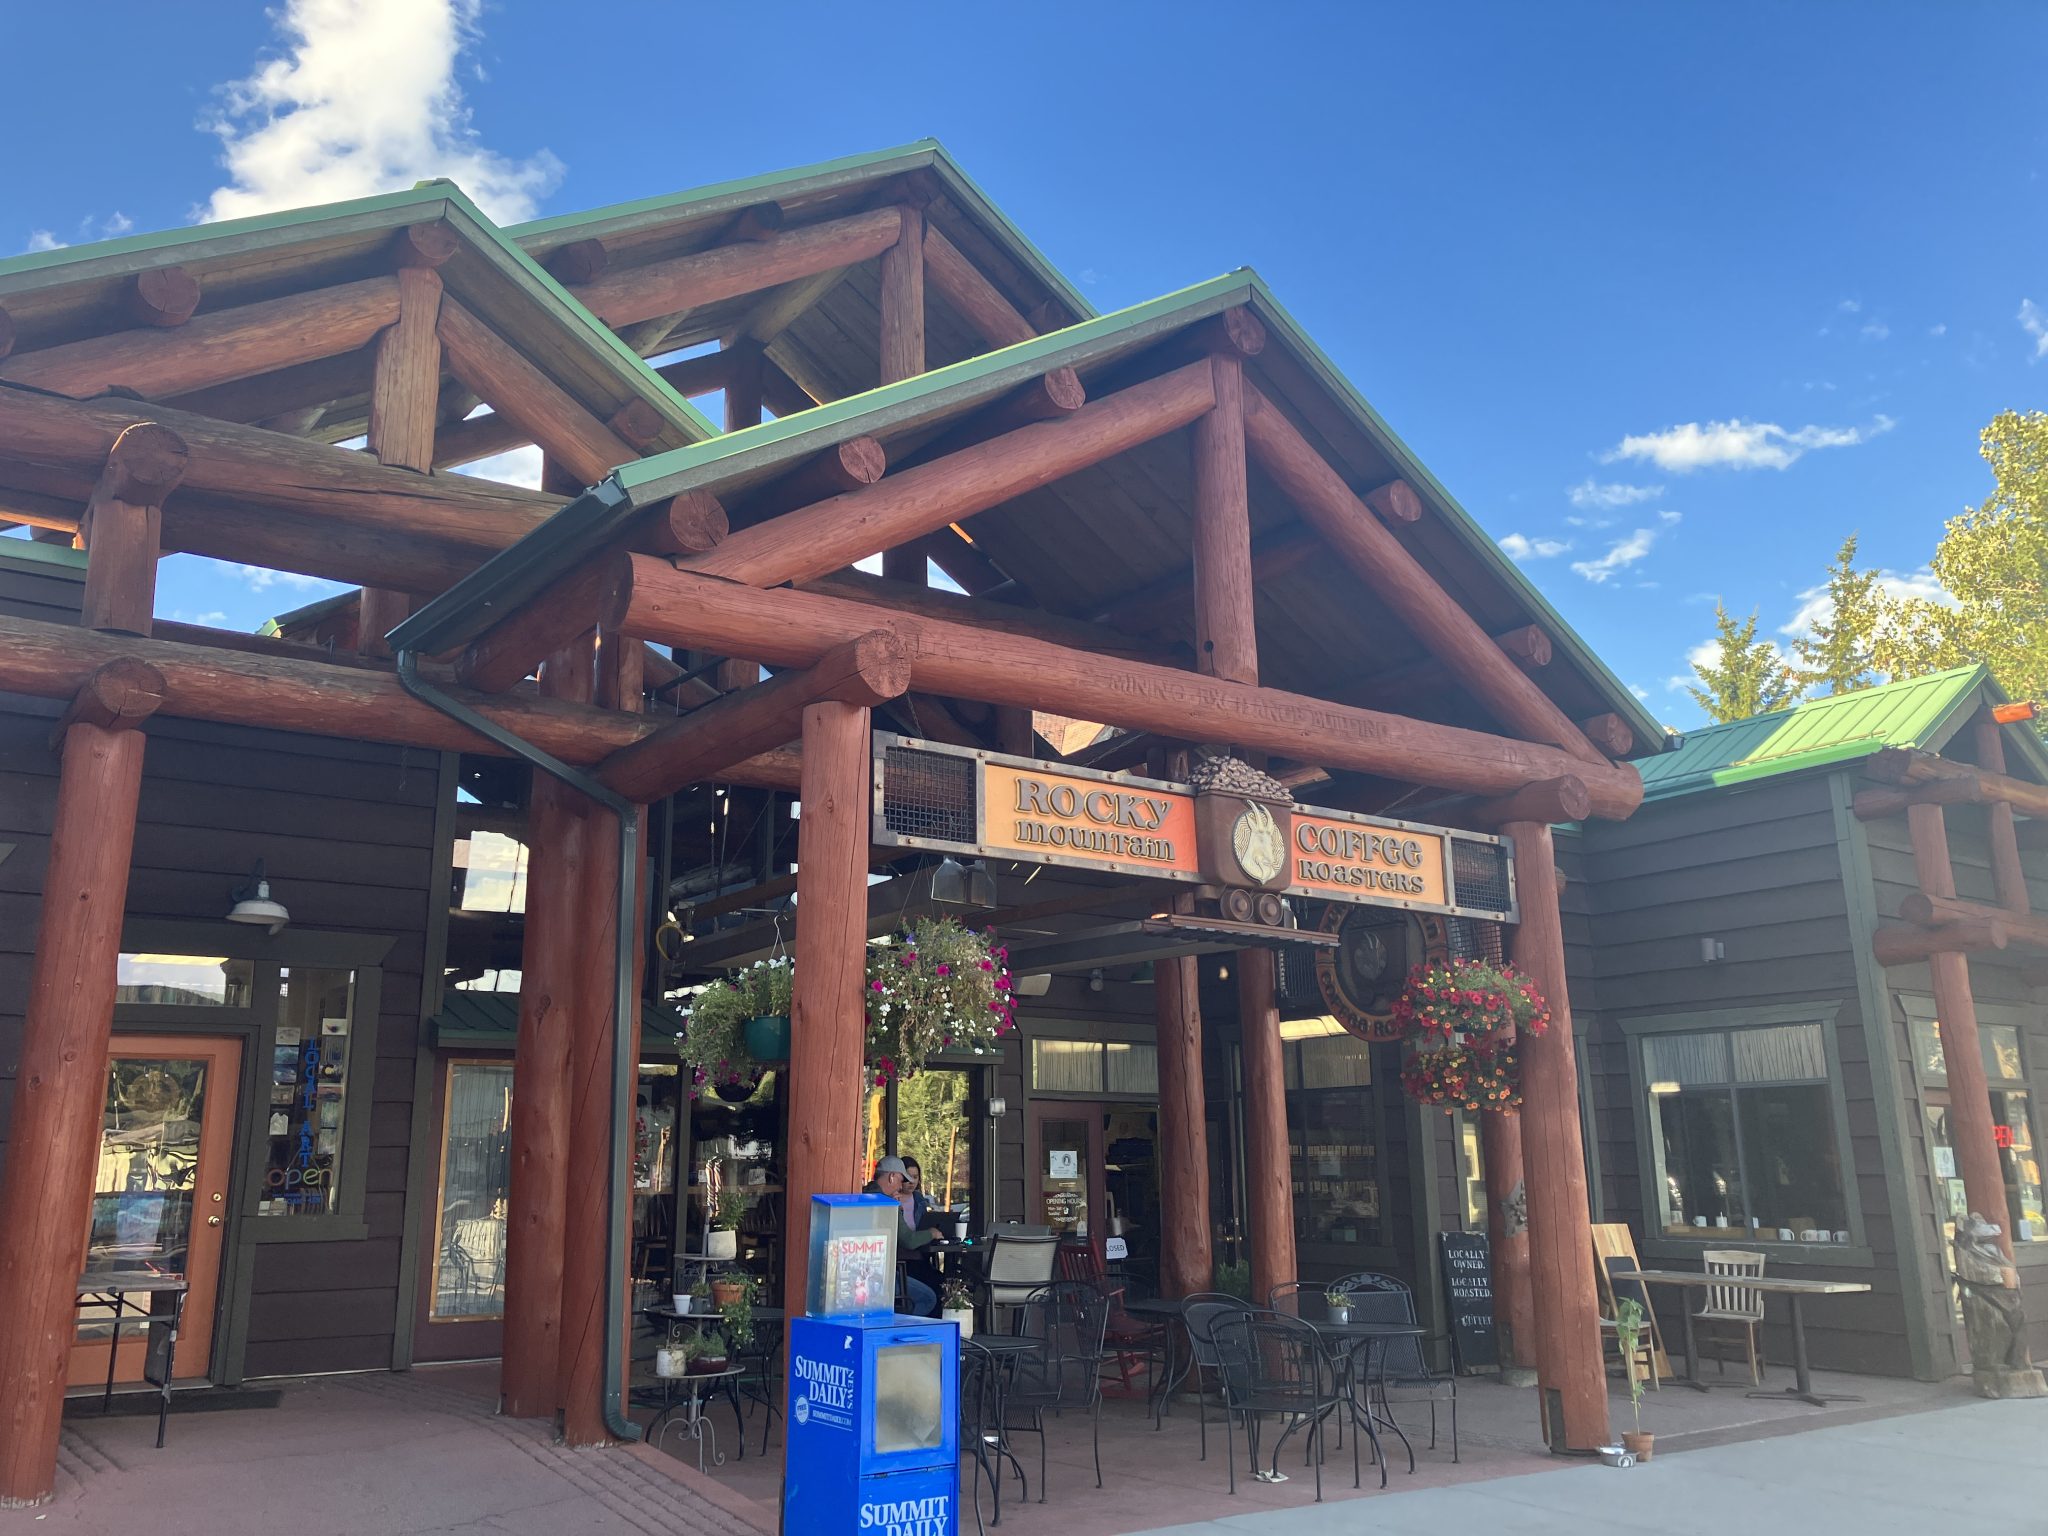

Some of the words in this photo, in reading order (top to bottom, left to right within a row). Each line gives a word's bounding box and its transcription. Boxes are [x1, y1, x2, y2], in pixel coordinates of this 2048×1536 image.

[1107, 672, 1184, 703] MINING
[1014, 777, 1174, 832] ROCKY
[1991, 1124, 2015, 1148] PEN
[267, 1168, 334, 1191] open
[841, 1241, 884, 1254] SUMMIT
[1448, 1250, 1485, 1259] LOCALLY
[795, 1355, 849, 1388] SUMMIT
[808, 1380, 848, 1409] DAILY
[847, 1369, 855, 1410] NEWS
[860, 1495, 949, 1529] SUMMIT
